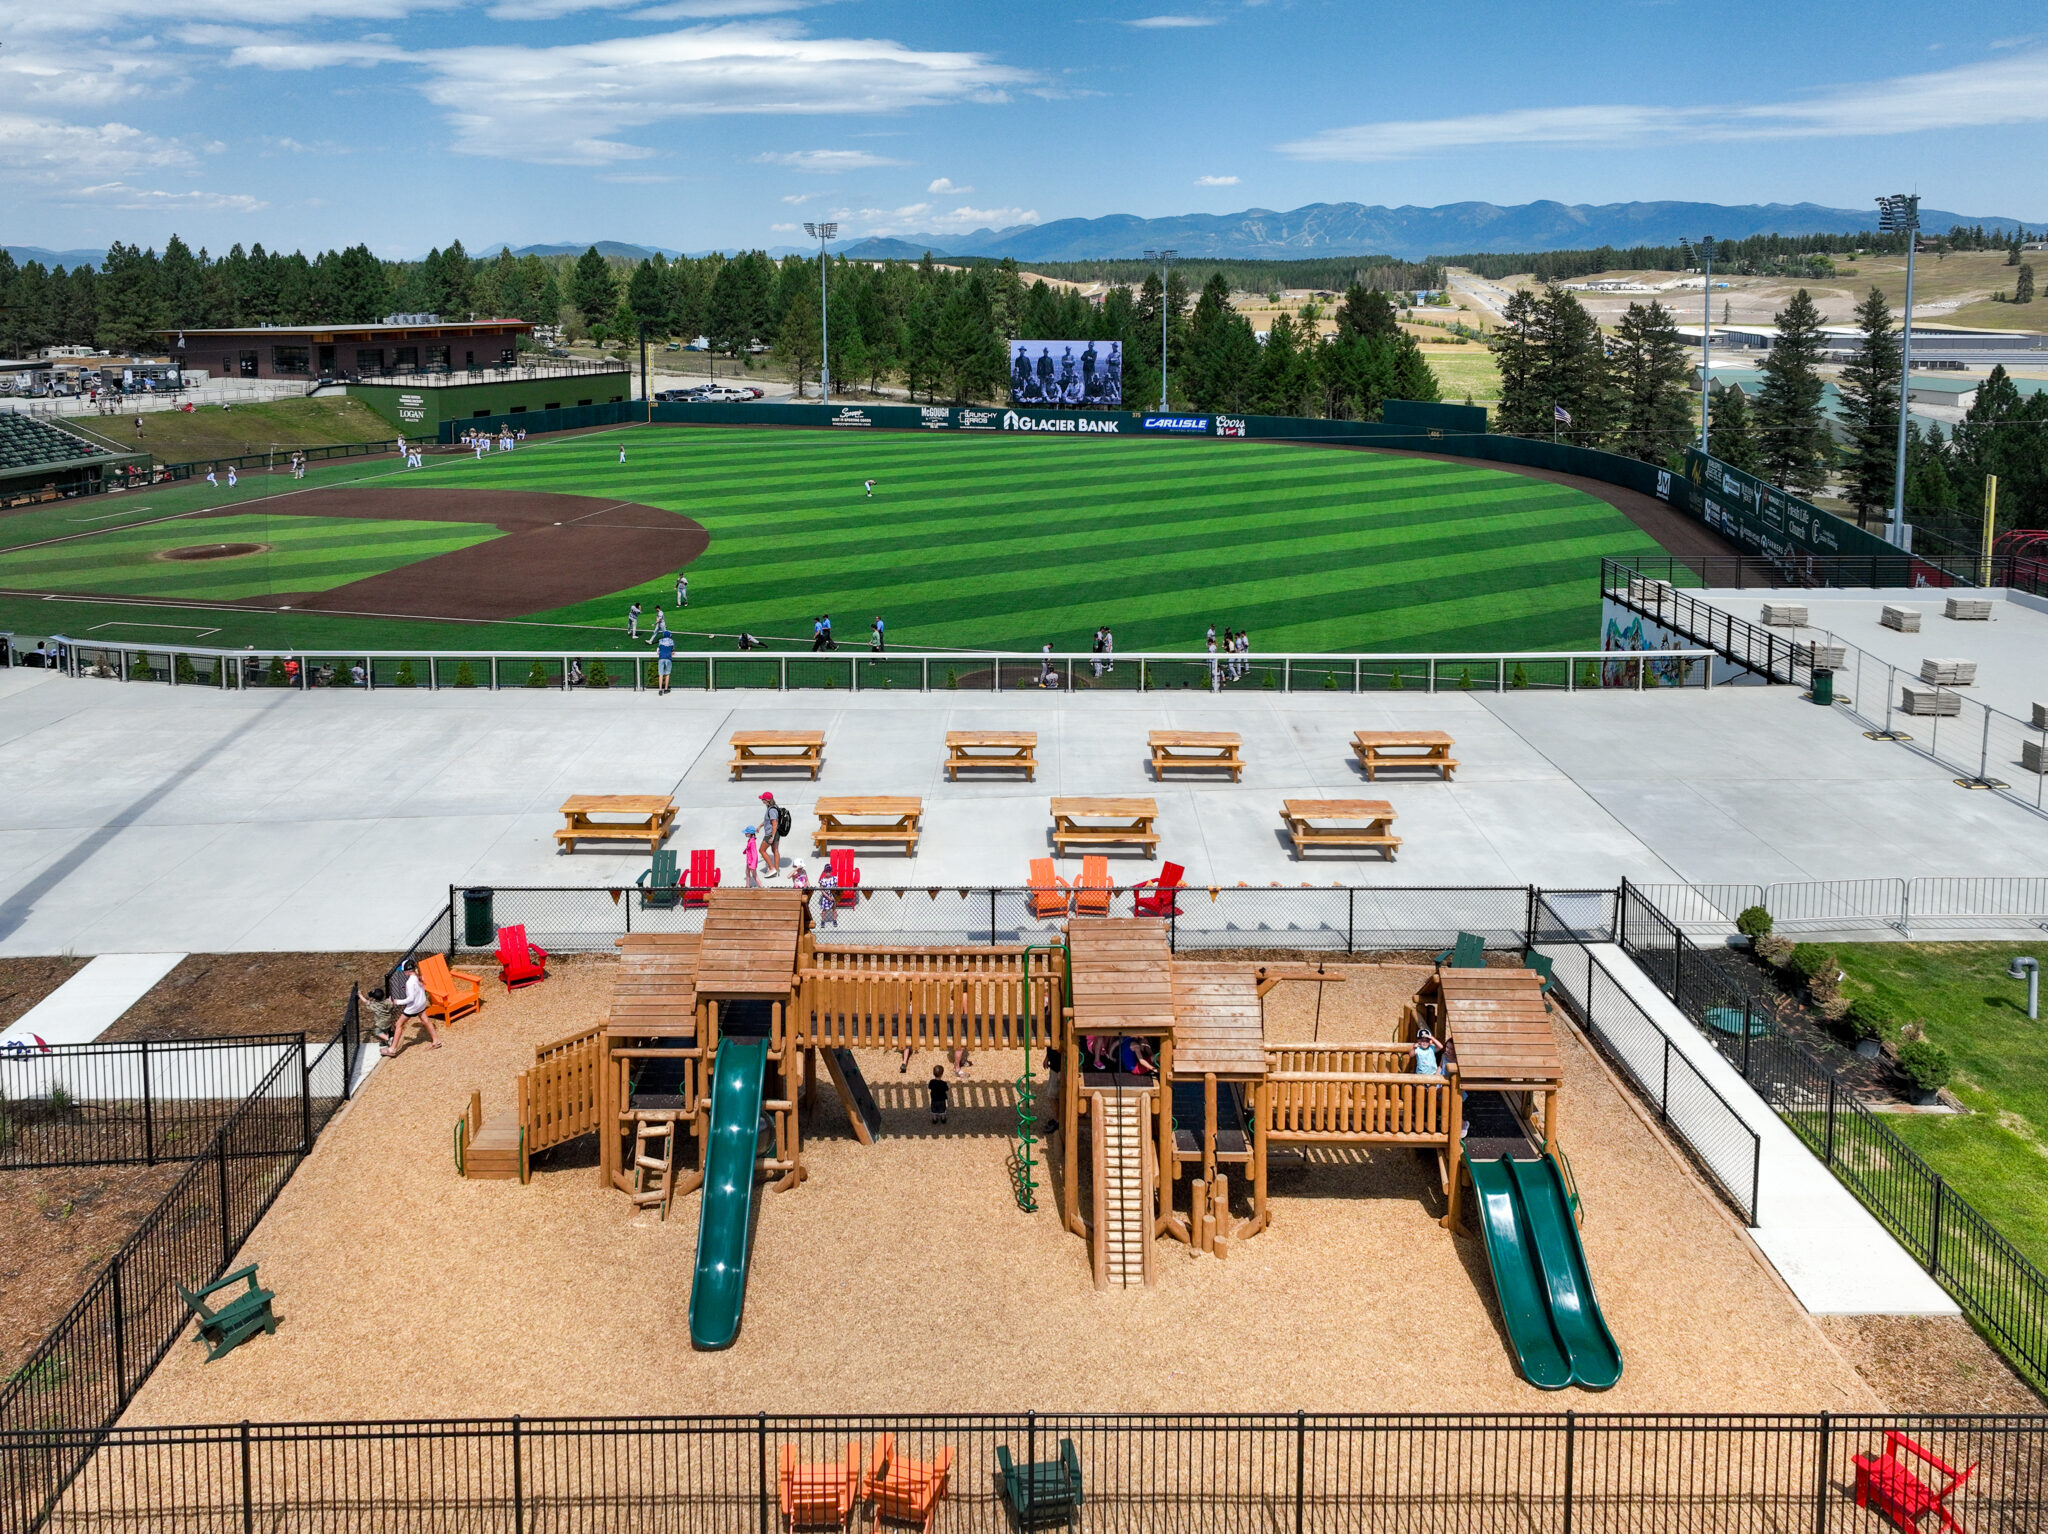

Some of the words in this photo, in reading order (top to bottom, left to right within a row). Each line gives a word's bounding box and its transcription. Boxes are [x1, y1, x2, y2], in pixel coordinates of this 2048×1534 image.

[399, 409, 424, 418] LOGAN
[921, 407, 949, 417] McGOUGH
[1019, 416, 1076, 431] GLACIER
[1078, 418, 1119, 433] BANK
[1144, 418, 1208, 428] CARLISLE
[1215, 415, 1245, 428] Coors
